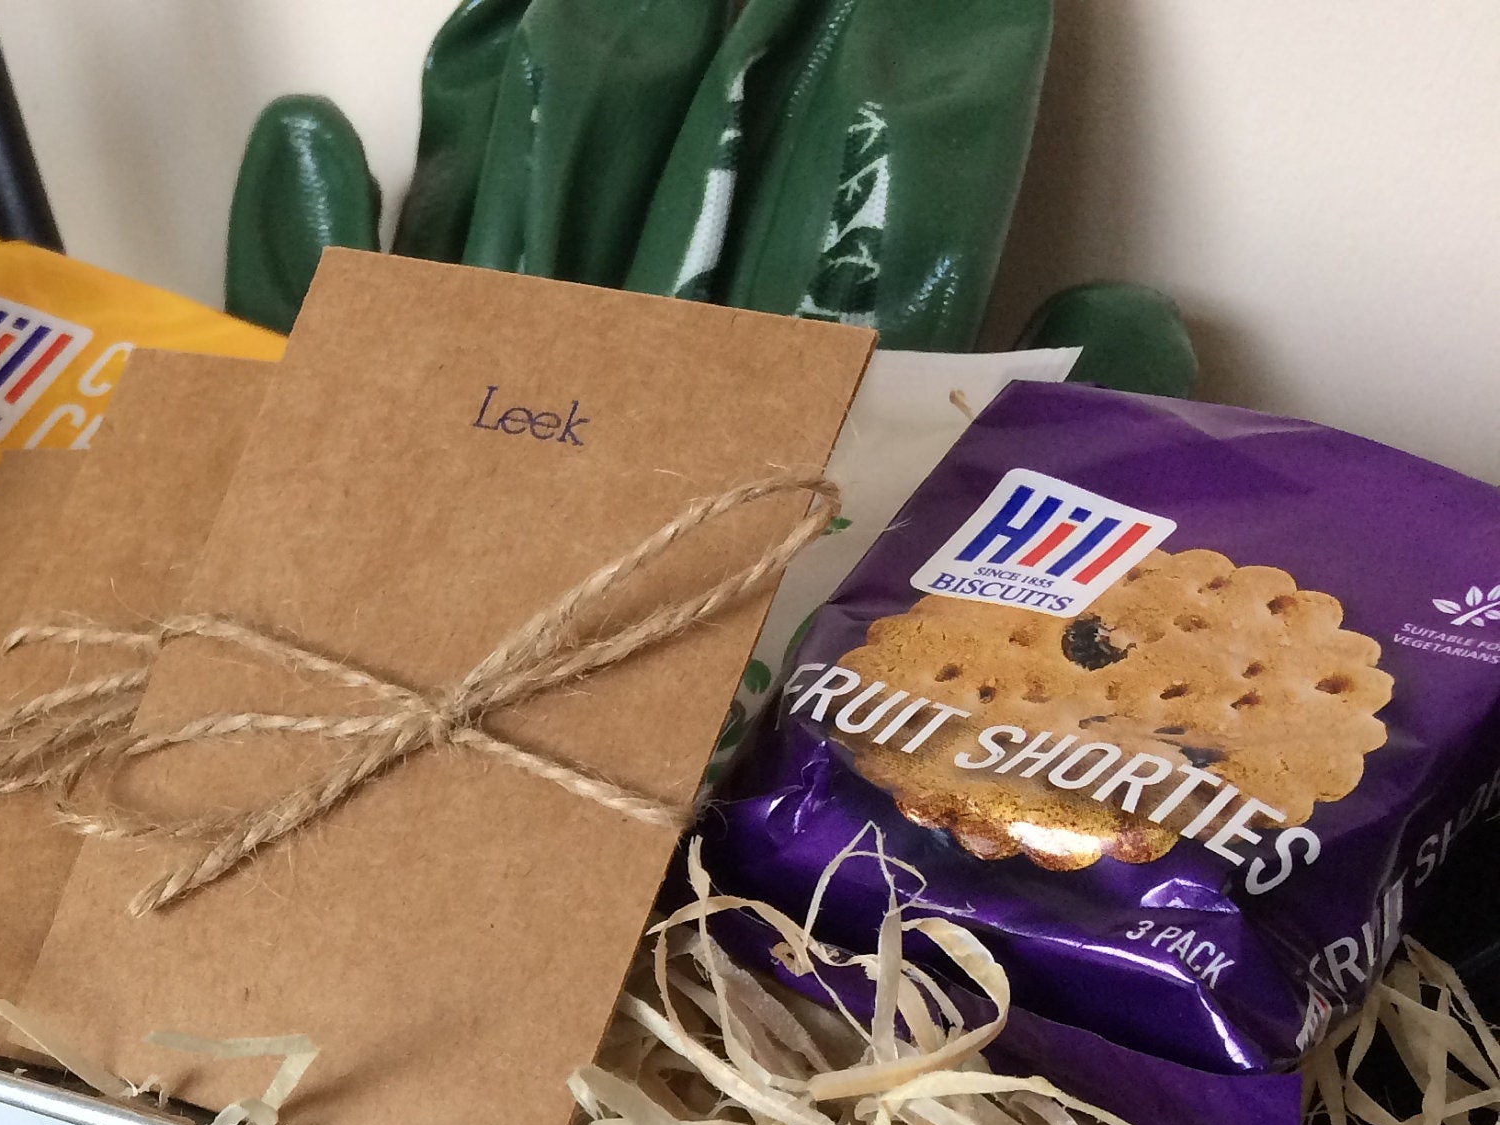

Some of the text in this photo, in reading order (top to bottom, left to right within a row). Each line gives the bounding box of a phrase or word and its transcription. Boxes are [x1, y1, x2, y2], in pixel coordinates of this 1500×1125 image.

[473, 386, 590, 446] Leek
[955, 484, 1152, 585] Hill
[927, 572, 1074, 612] BISCUITS
[973, 566, 1055, 589] SINCE 1855
[1393, 633, 1500, 665] VEGETARIANS
[1401, 623, 1500, 652] SUITABLE FO
[782, 662, 1321, 896] FRUIT SHORTIES
[1125, 919, 1236, 989] 3 PACK
